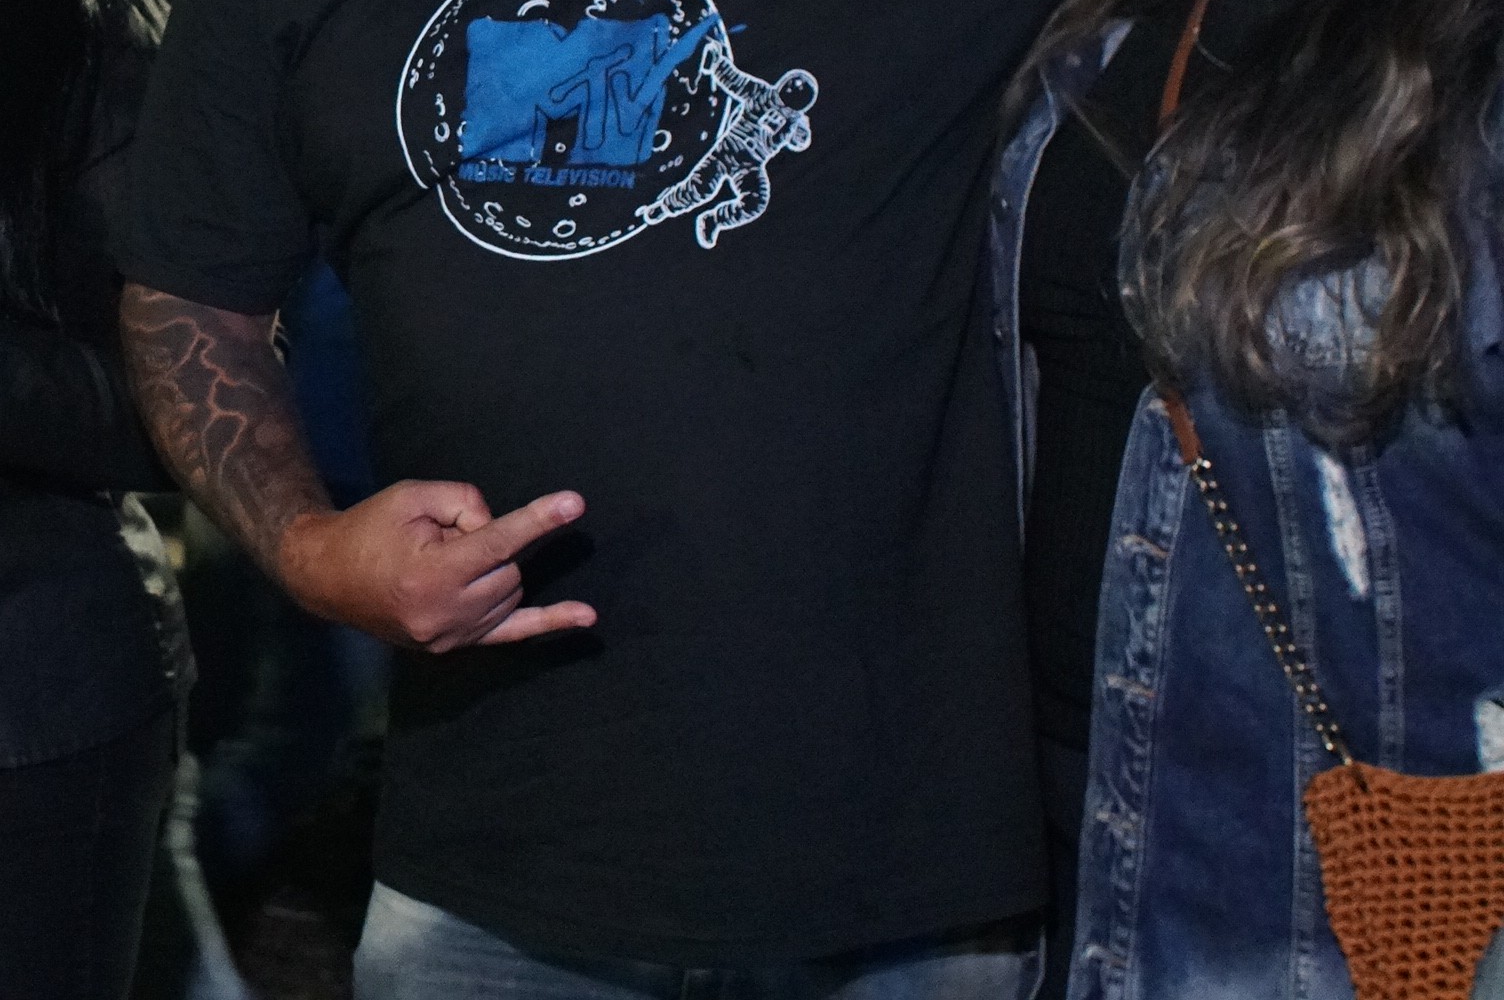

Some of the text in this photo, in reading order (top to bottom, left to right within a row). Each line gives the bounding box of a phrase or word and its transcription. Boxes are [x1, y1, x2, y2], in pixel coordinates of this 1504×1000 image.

[460, 12, 722, 166] MTV
[458, 161, 637, 190] MUSIC TELEVISION
